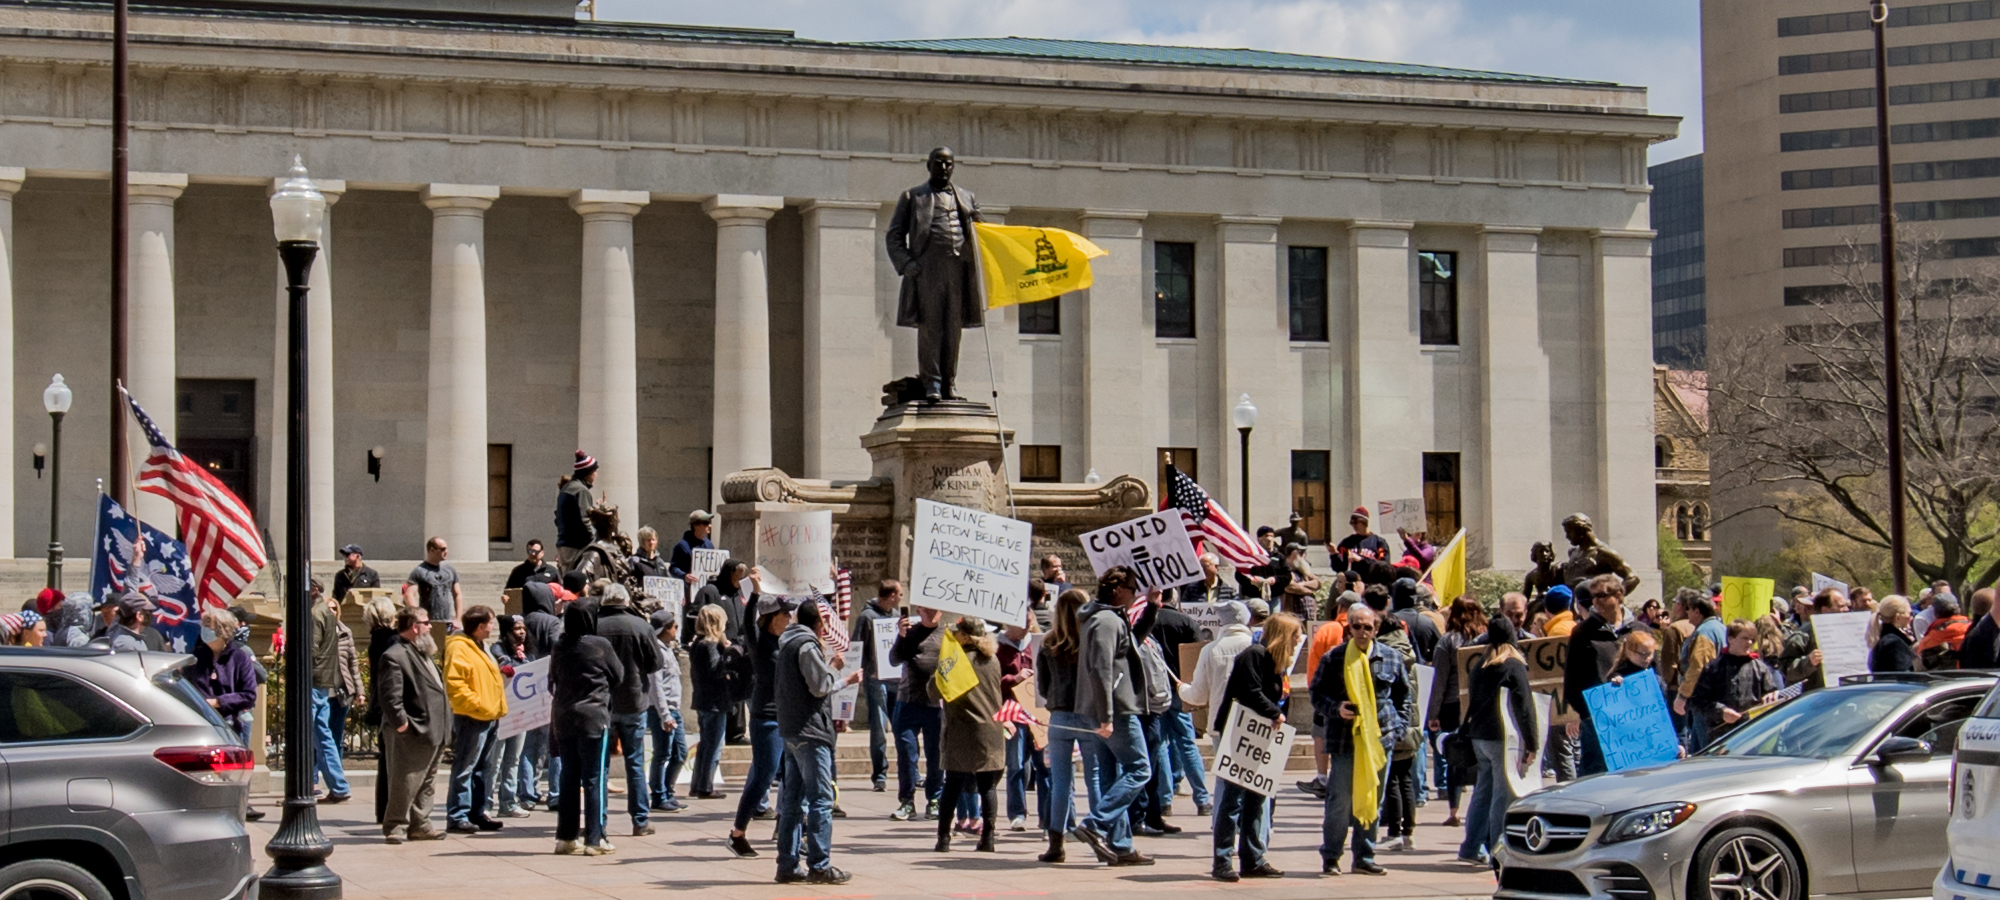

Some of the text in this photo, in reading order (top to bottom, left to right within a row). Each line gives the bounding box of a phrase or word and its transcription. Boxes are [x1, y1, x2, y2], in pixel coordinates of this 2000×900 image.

[932, 465, 983, 477] WILLIAM
[932, 504, 987, 529] DEWINE
[1395, 500, 1420, 515] Ohio
[930, 522, 971, 538] ACTON
[975, 530, 1023, 552] BELIEVE
[1089, 517, 1167, 553] COVID
[929, 538, 1020, 575] ABORTIONS
[963, 569, 985, 584] ARE
[1134, 552, 1201, 593] NTROL
[877, 622, 893, 634] THE
[1236, 709, 1286, 746] I am a
[1594, 701, 1666, 733] Overcomes
[1235, 735, 1272, 765] Free
[1600, 723, 1662, 753] Viruses
[1605, 739, 1673, 771] Illnesses
[1217, 754, 1274, 793] Person
